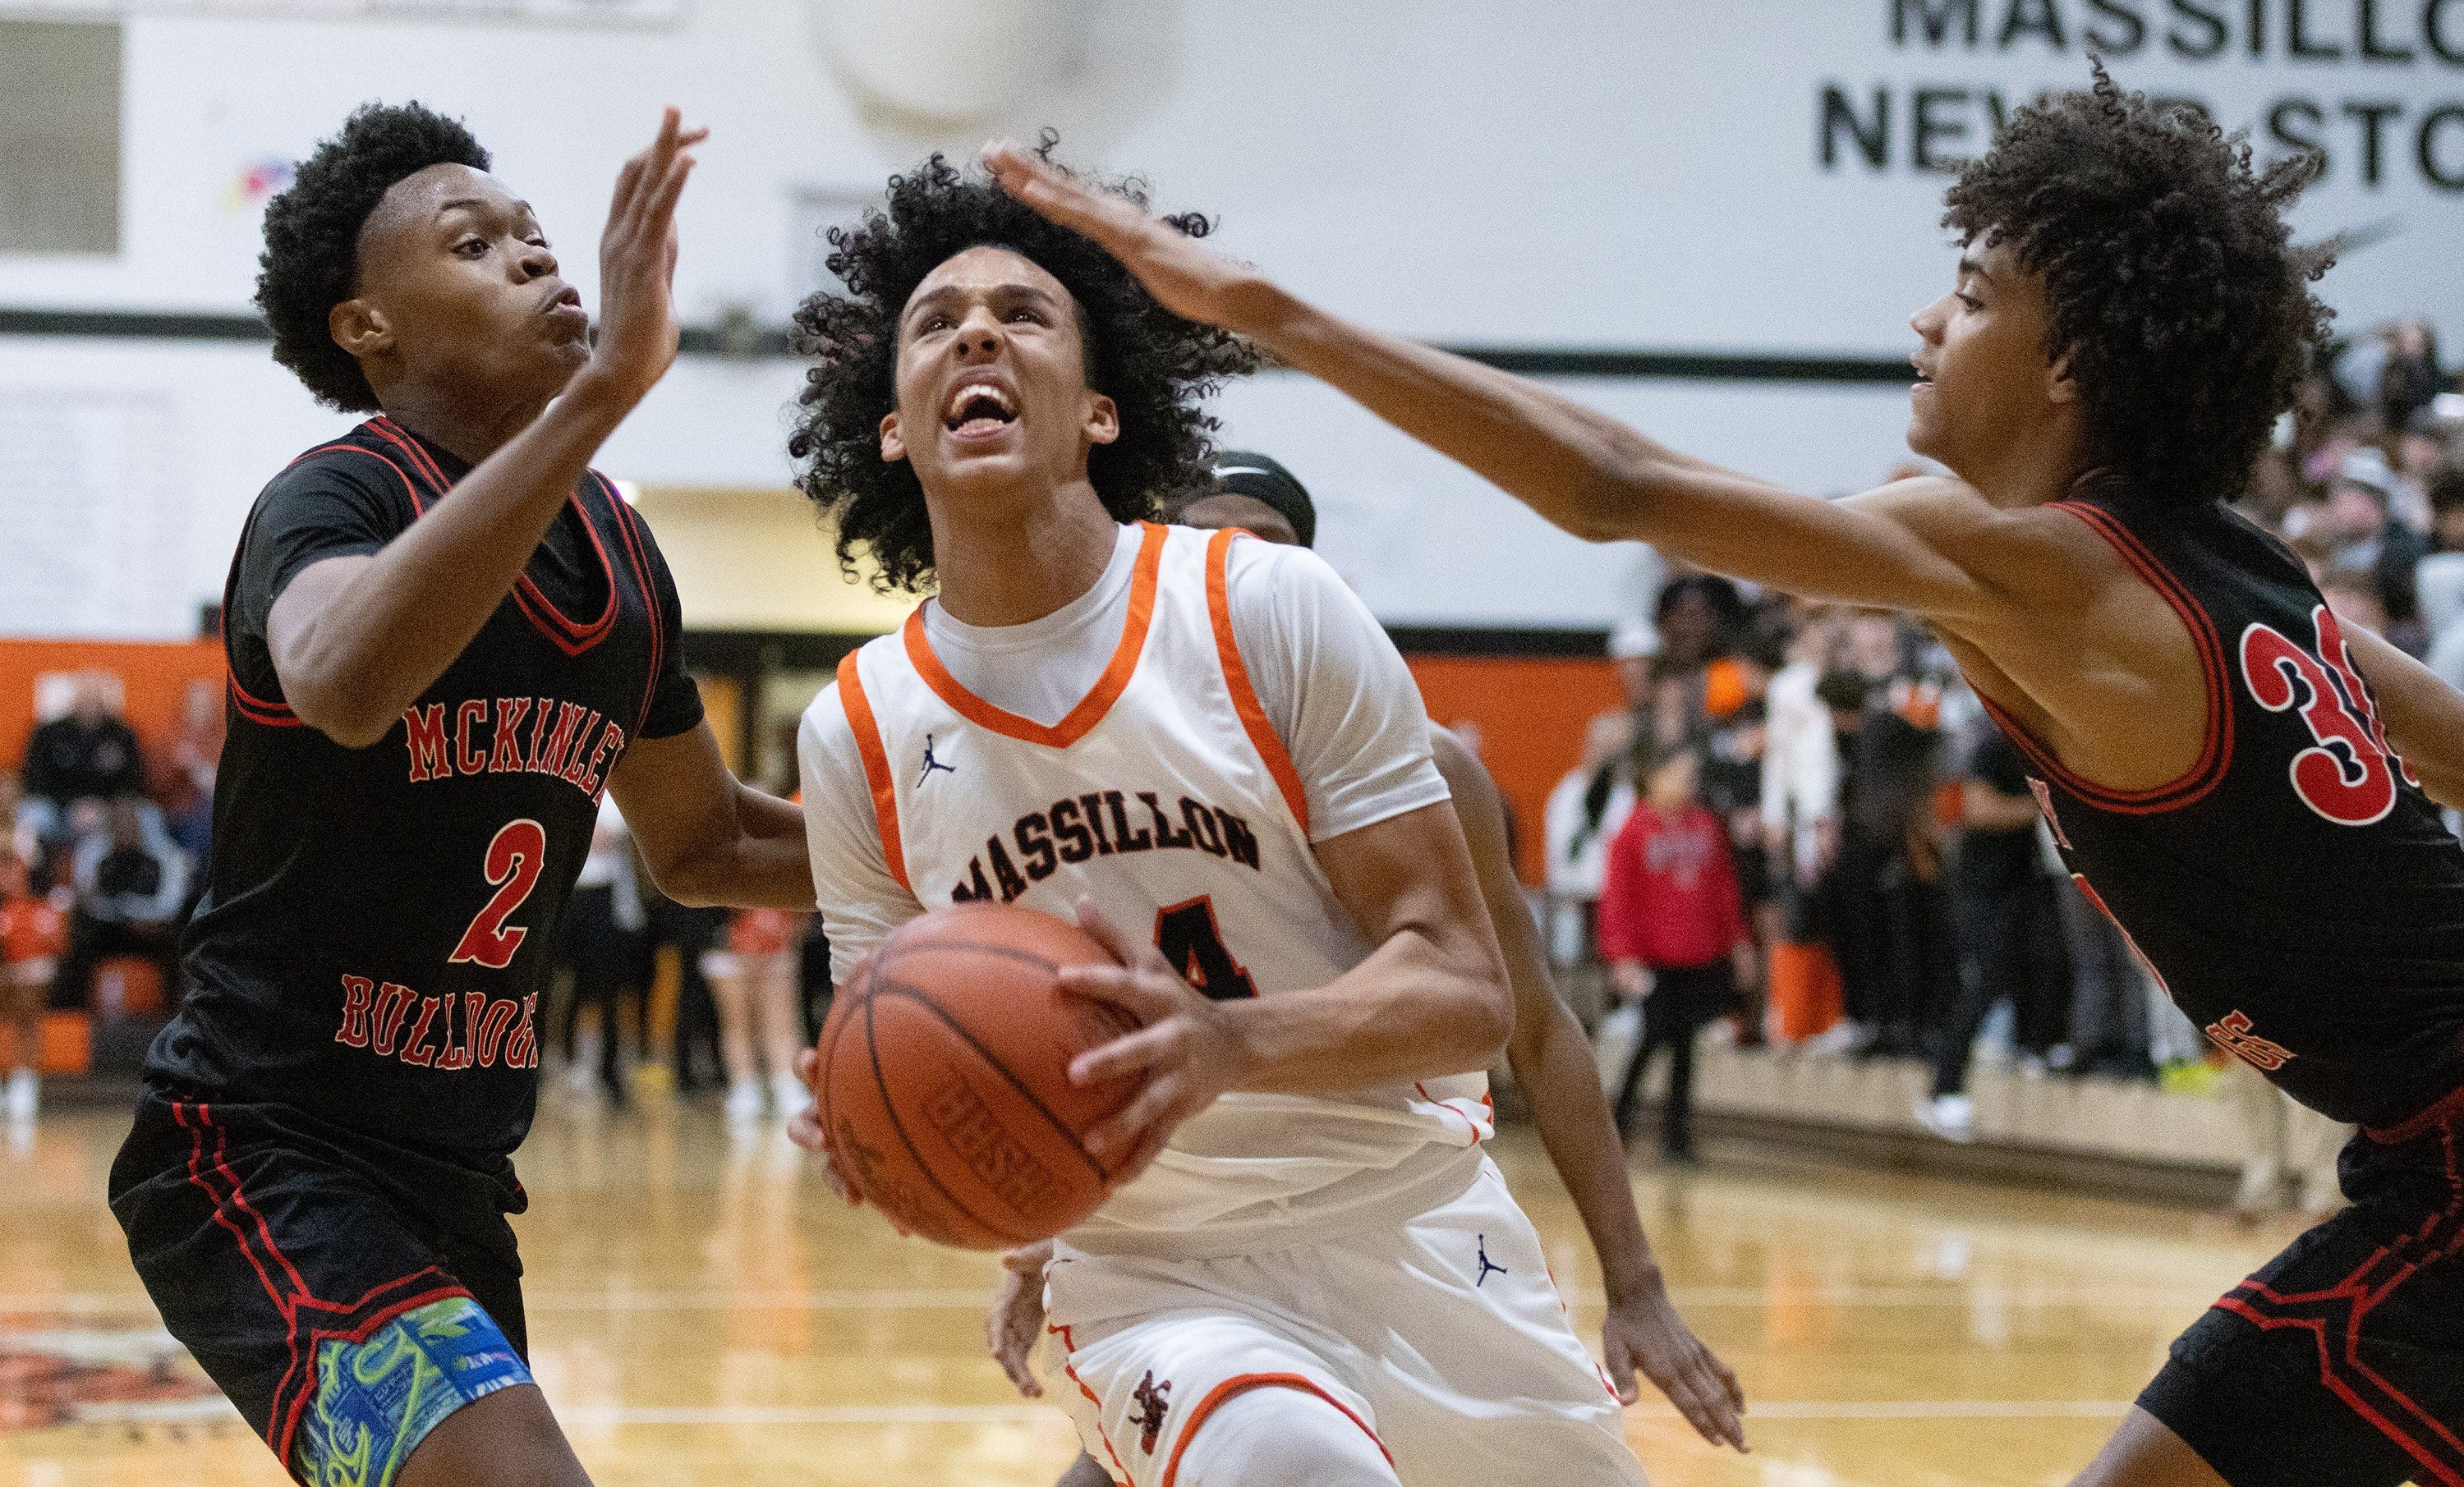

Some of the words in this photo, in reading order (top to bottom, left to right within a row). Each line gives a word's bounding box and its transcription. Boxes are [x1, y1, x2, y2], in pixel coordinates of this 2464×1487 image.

[402, 696, 625, 807] MCKINLE
[448, 818, 545, 969] 2
[1153, 893, 1259, 1000] 4
